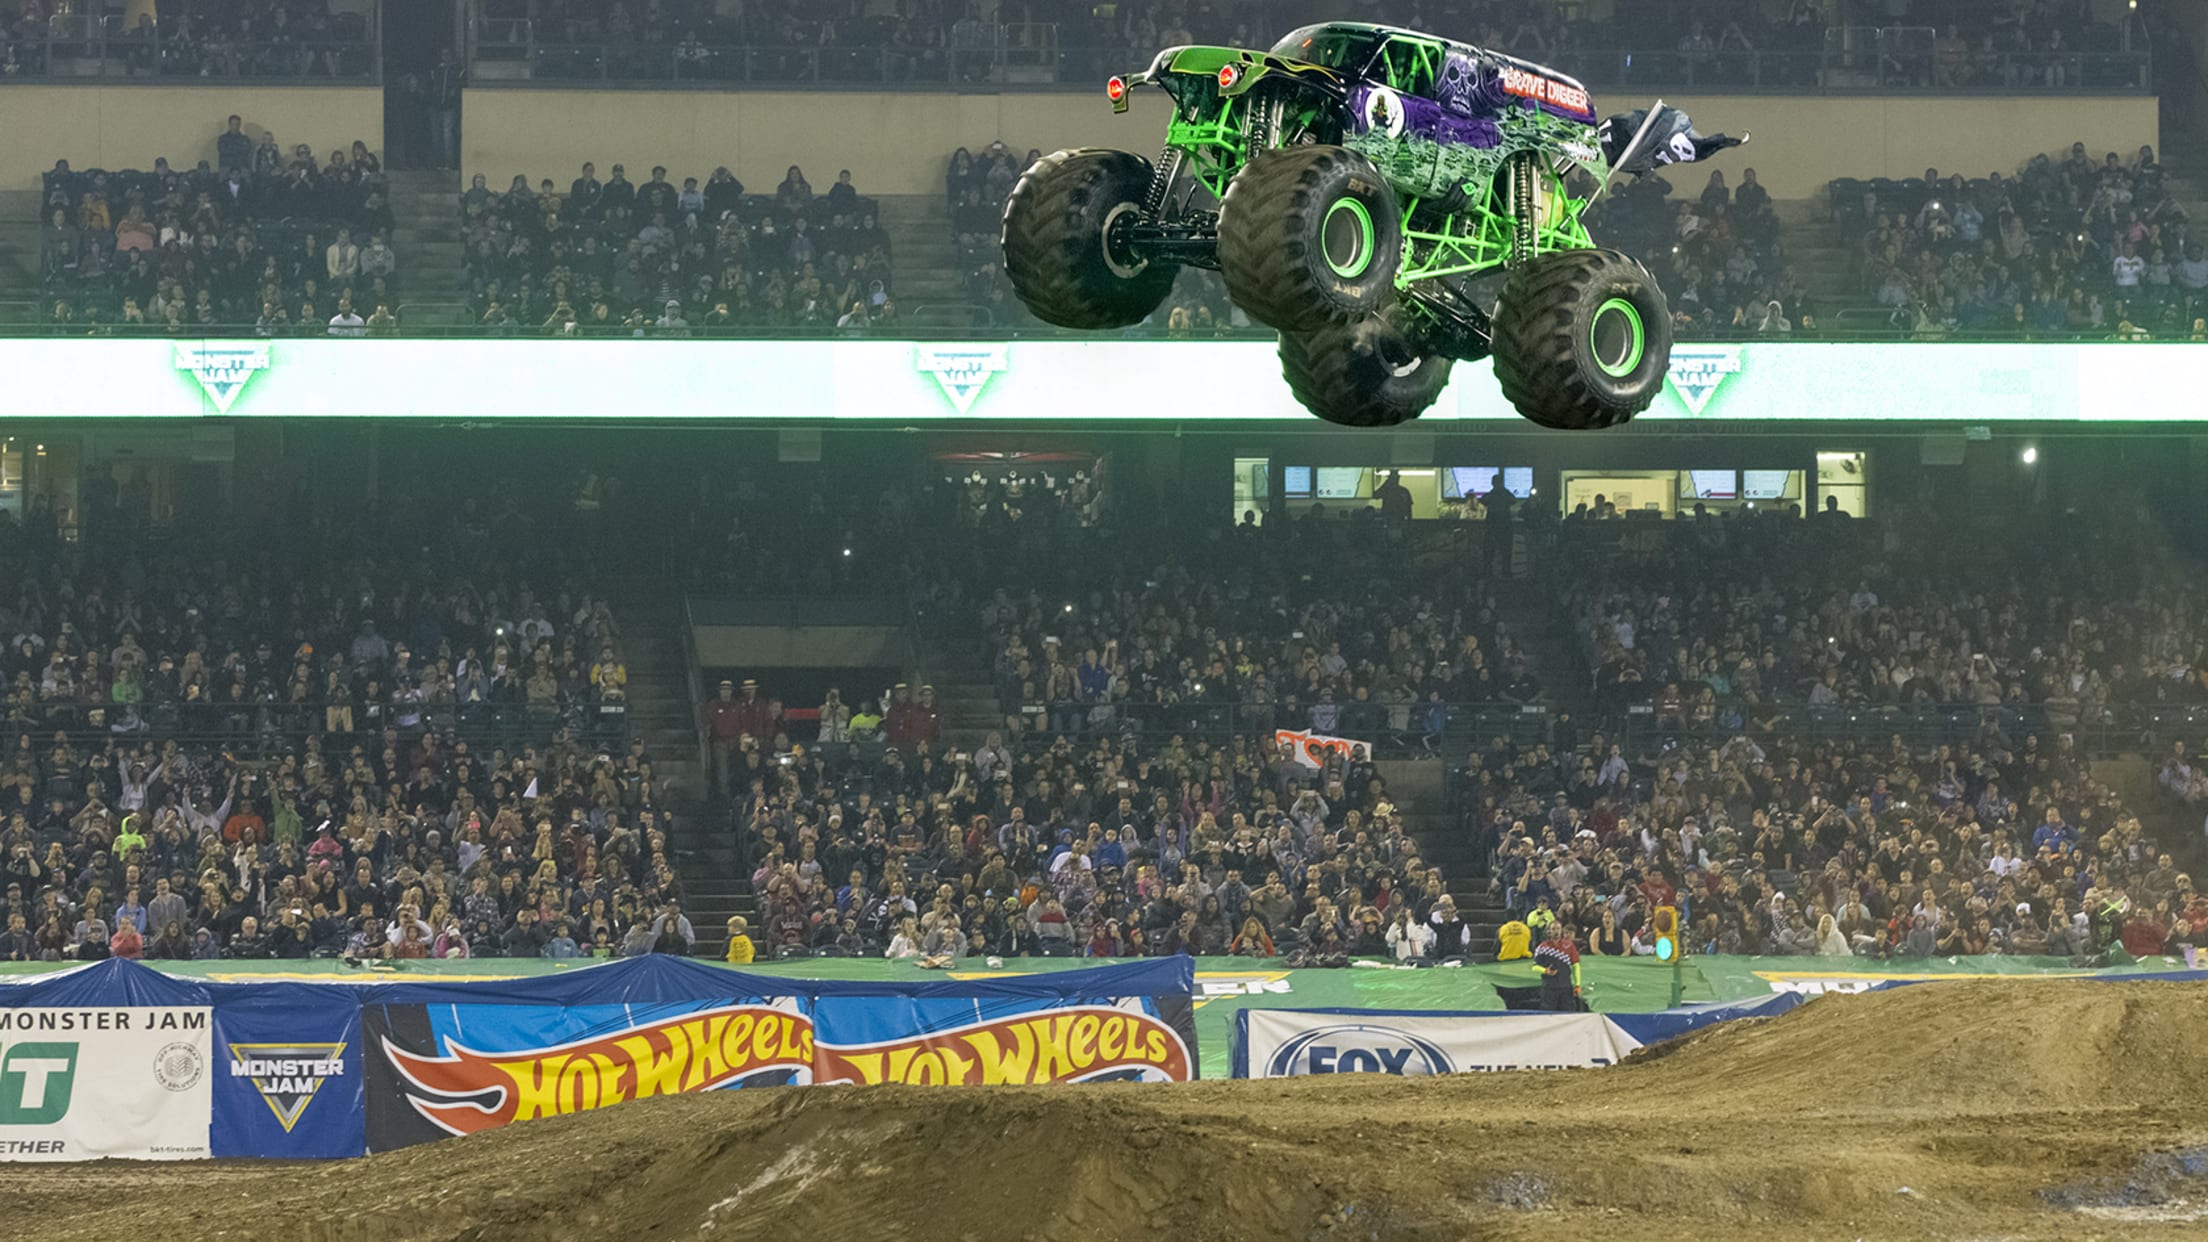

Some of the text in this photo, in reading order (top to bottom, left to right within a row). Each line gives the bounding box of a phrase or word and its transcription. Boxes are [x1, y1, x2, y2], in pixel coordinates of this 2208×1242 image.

[1503, 69, 1588, 112] GRAVE DIGGER
[1347, 178, 1378, 196] BKT
[175, 354, 270, 369] MONSTER
[1668, 357, 1740, 372] ONSTER
[145, 1012, 205, 1030] JAM
[231, 1060, 344, 1077] MONSTER
[1309, 1046, 1414, 1076] FOX
[263, 1077, 314, 1094] JAM
[490, 1053, 628, 1124] HOT
